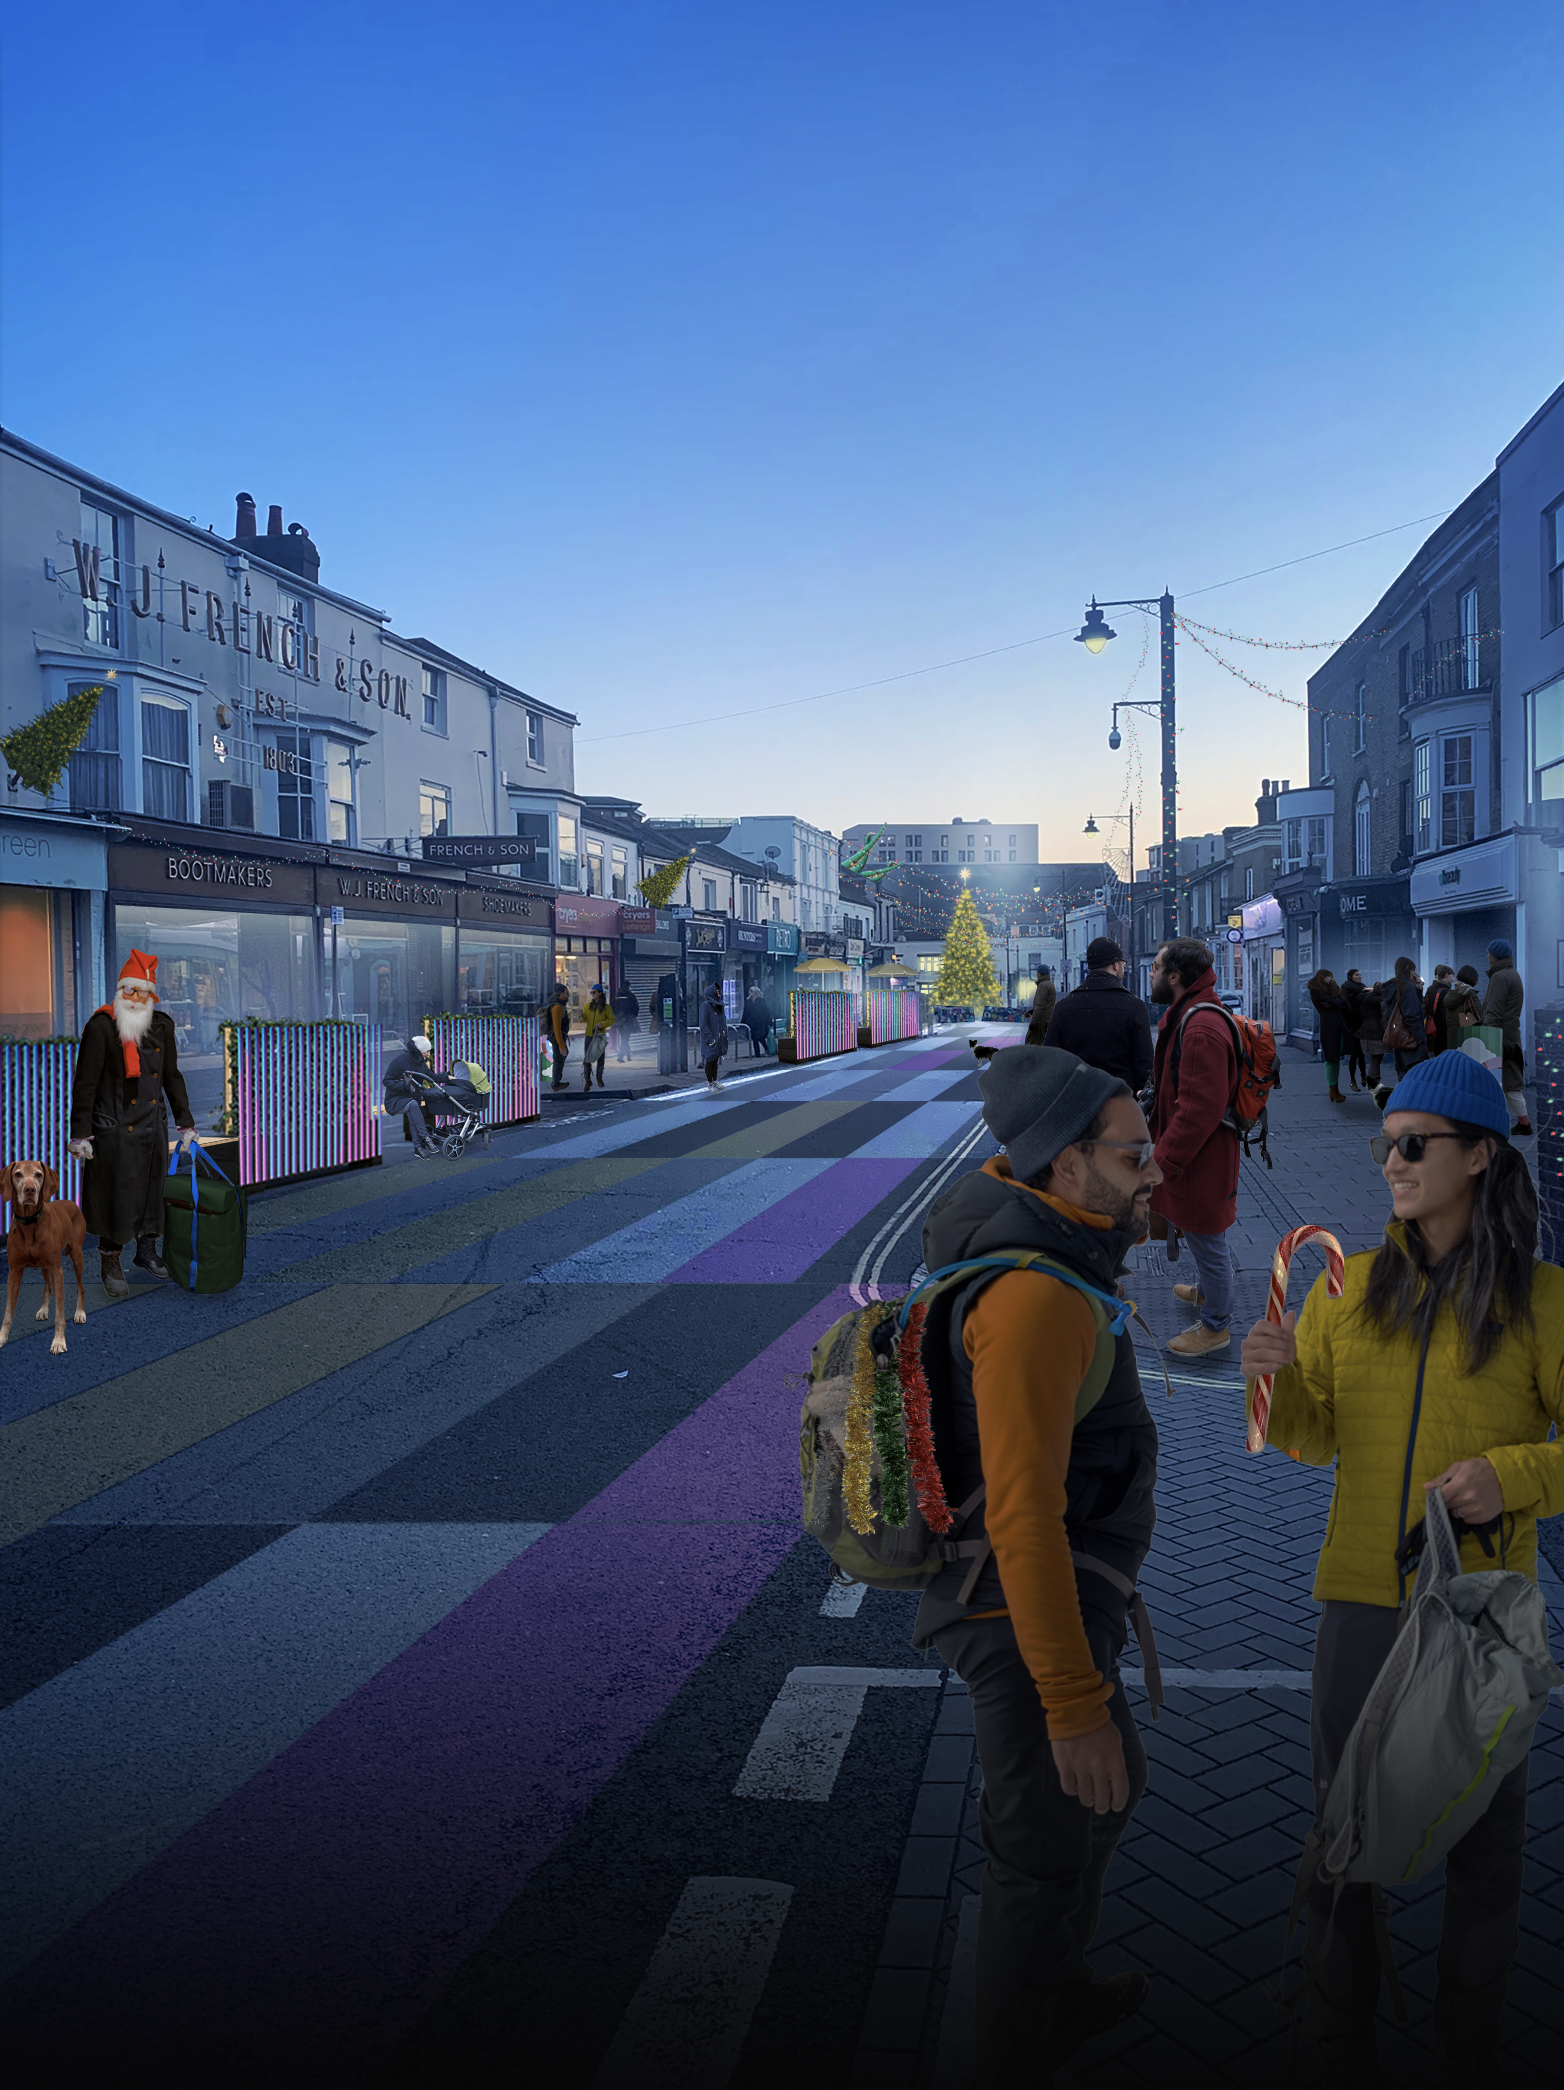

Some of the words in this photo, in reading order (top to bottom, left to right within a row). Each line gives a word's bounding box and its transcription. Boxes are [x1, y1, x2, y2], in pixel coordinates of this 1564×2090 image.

[180, 579, 320, 682] FRENCH
[335, 657, 348, 693] &
[254, 687, 287, 722] EST
[263, 744, 297, 774] 1803
[0, 834, 51, 858] reen
[429, 844, 483, 856] FRENCH
[487, 847, 495, 856] &
[500, 844, 529, 855] SON
[167, 857, 273, 888] BOOTMAKERS
[367, 881, 409, 902] FRENCH
[413, 887, 420, 903] &
[423, 887, 444, 905] SON
[483, 895, 532, 916] SHOEMAKERS
[622, 910, 651, 921] cryers
